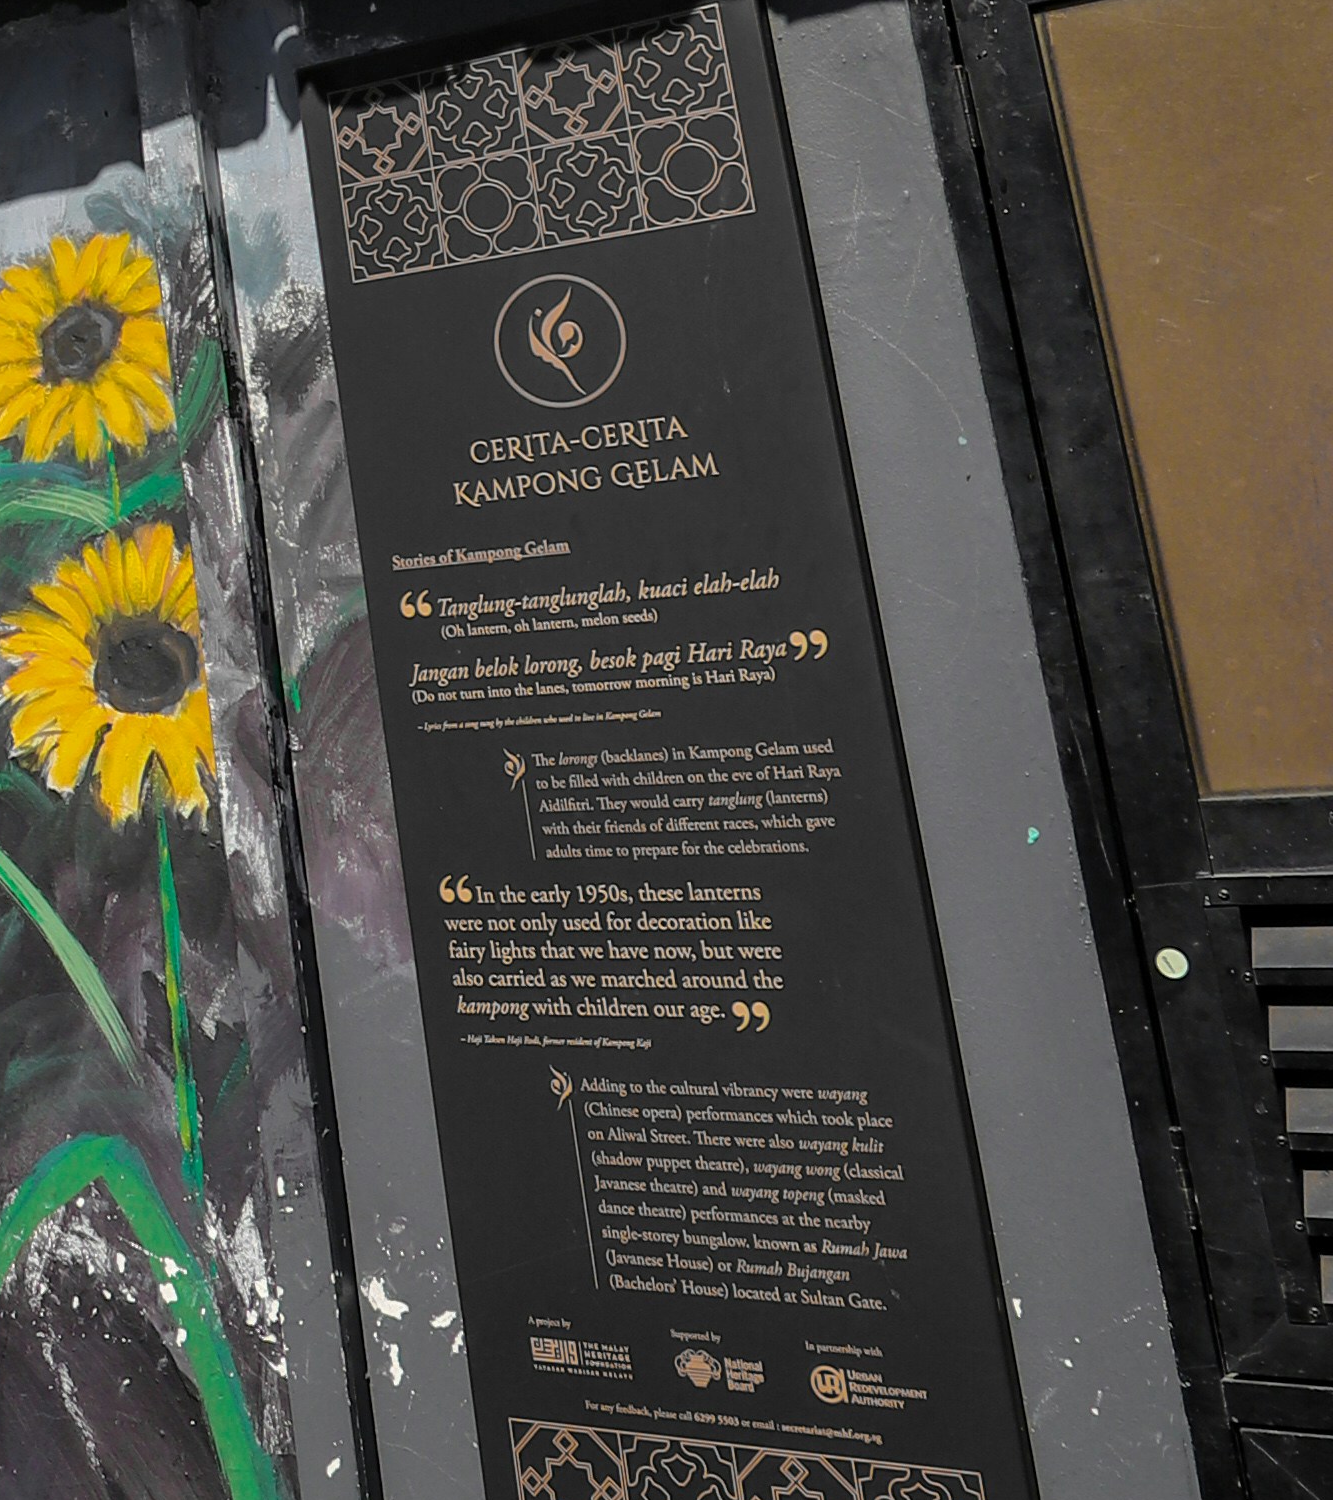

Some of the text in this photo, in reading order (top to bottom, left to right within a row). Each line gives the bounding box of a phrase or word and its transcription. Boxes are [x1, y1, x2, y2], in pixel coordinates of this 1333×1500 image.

[469, 415, 689, 464] CERITA-CERITA
[452, 452, 720, 507] KAMPONG GELAM
[392, 540, 571, 569] Stories of Kampong Gelam
[638, 577, 688, 601] kuaci
[693, 566, 780, 596] elah-elah
[441, 608, 658, 641] (Oh lantern, oh lantern, melon seeds)
[409, 663, 469, 687] Jangan
[474, 655, 519, 679] belok
[524, 654, 584, 677] lorong,
[590, 647, 637, 670] besok
[641, 646, 682, 673] pagi
[687, 641, 733, 664] Hari
[412, 667, 775, 704] (Do not turn into the lanes, tomorrow morning is Hari Raya)
[531, 752, 556, 767] The
[600, 746, 669, 766] (backlanes)
[671, 747, 686, 760] in
[688, 745, 754, 763] Kampong
[755, 741, 800, 757] Gelam
[802, 738, 834, 754] used
[539, 787, 828, 814] Aidilfitri. They would carry tanglung (lanterns)
[546, 839, 809, 861] adults time to prepare for the celebrations.
[499, 884, 526, 903] the
[530, 883, 571, 908] early
[576, 884, 633, 905] 1950s,
[638, 882, 684, 902] these
[687, 881, 761, 901] lanterns
[444, 909, 772, 937] were not only used for decoration like
[452, 967, 784, 989] also carried as we marched around the
[457, 994, 530, 1021] kampong
[531, 996, 573, 1016] with
[576, 996, 649, 1017] children
[653, 1004, 685, 1018] our
[580, 1077, 868, 1106] Adding to the cultural vibrancy were wayang
[584, 1101, 893, 1132] (Chinese opera) performances which took place
[602, 1225, 680, 1247] single-storey
[752, 1233, 801, 1252] known
[803, 1242, 818, 1254] as
[821, 1238, 870, 1256] Rumah
[872, 1242, 908, 1264] Jawa
[606, 1248, 850, 1285] (Javanese House) or Rumah Bujangan
[680, 1279, 729, 1300] House)
[732, 1283, 781, 1302] located
[784, 1292, 798, 1304] at
[800, 1288, 845, 1307] Sultan
[848, 1292, 887, 1311] Gate.
